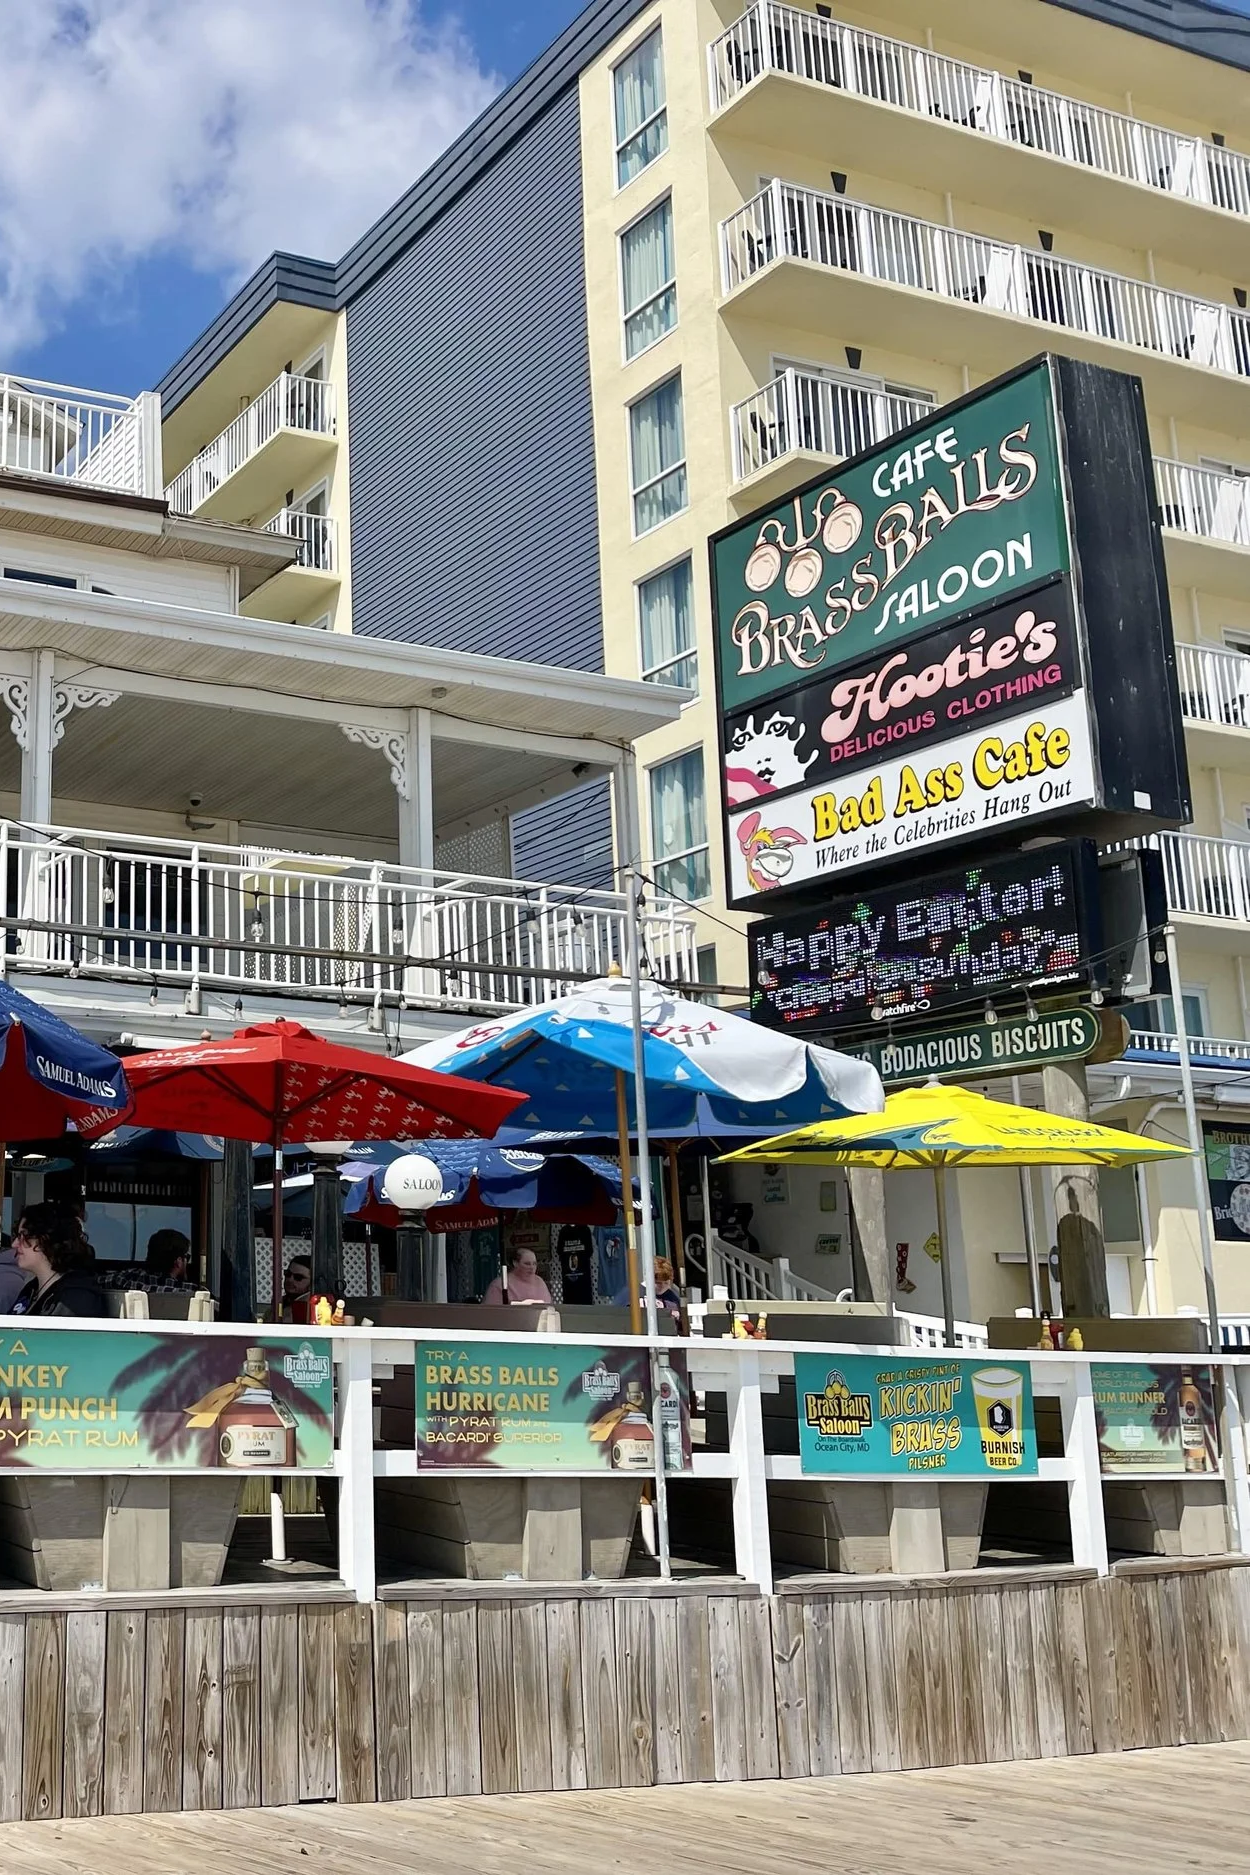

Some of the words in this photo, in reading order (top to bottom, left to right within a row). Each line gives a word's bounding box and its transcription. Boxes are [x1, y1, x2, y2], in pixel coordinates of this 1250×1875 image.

[872, 426, 959, 498] CAFE
[731, 552, 880, 676] BRASS
[875, 421, 1038, 591] BALLS
[874, 532, 1033, 636] SALOON
[820, 610, 1058, 744] Hootie's
[830, 710, 936, 763] DELICIOUS
[946, 664, 1062, 719] CLOTHING
[811, 776, 886, 842] Bad
[893, 765, 964, 818] Ass
[973, 721, 1071, 790] Cafe
[815, 846, 860, 870] Where
[865, 834, 887, 855] the
[894, 808, 976, 846] Celebrities
[983, 793, 1031, 821] Hang
[1039, 779, 1072, 803] Out
[881, 1003, 916, 1016] atchfire
[881, 1033, 982, 1075] BODACIOUS
[991, 1016, 1085, 1058] BISCUITS
[36, 1055, 76, 1086] SAMUEL
[76, 1072, 117, 1098] ADAMS
[1212, 1130, 1250, 1145] BROTH
[9, 1339, 29, 1356] A
[425, 1351, 453, 1361] TRY
[458, 1351, 470, 1361] A
[286, 1357, 308, 1372] Brass
[309, 1358, 328, 1372] Balls
[293, 1371, 321, 1382] Saloon
[425, 1365, 492, 1385] BRASS
[497, 1366, 559, 1387] BALLS
[1093, 1370, 1112, 1379] OME
[425, 1391, 550, 1412] HURRICANE
[879, 1376, 962, 1419] KICKIN'
[1119, 1391, 1166, 1404] RUNNER
[21, 1397, 117, 1421] PUNCH
[806, 1394, 839, 1419] Brass
[840, 1396, 870, 1420] Balls
[425, 1415, 448, 1423] WITH
[449, 1416, 499, 1428] PYRAT
[500, 1416, 531, 1428] RUM
[819, 1417, 861, 1435] Saloon
[85, 1430, 139, 1447] RUM
[237, 1431, 276, 1441] PYRAT
[493, 1432, 562, 1444] SUPERIOR
[889, 1416, 962, 1456] BRASS
[814, 1441, 838, 1452] Ocean
[839, 1442, 856, 1454] City,
[857, 1443, 870, 1452] MD
[981, 1440, 1025, 1455] BURNISH
[908, 1454, 947, 1471] PILSNER
[989, 1456, 1005, 1466] BEER
